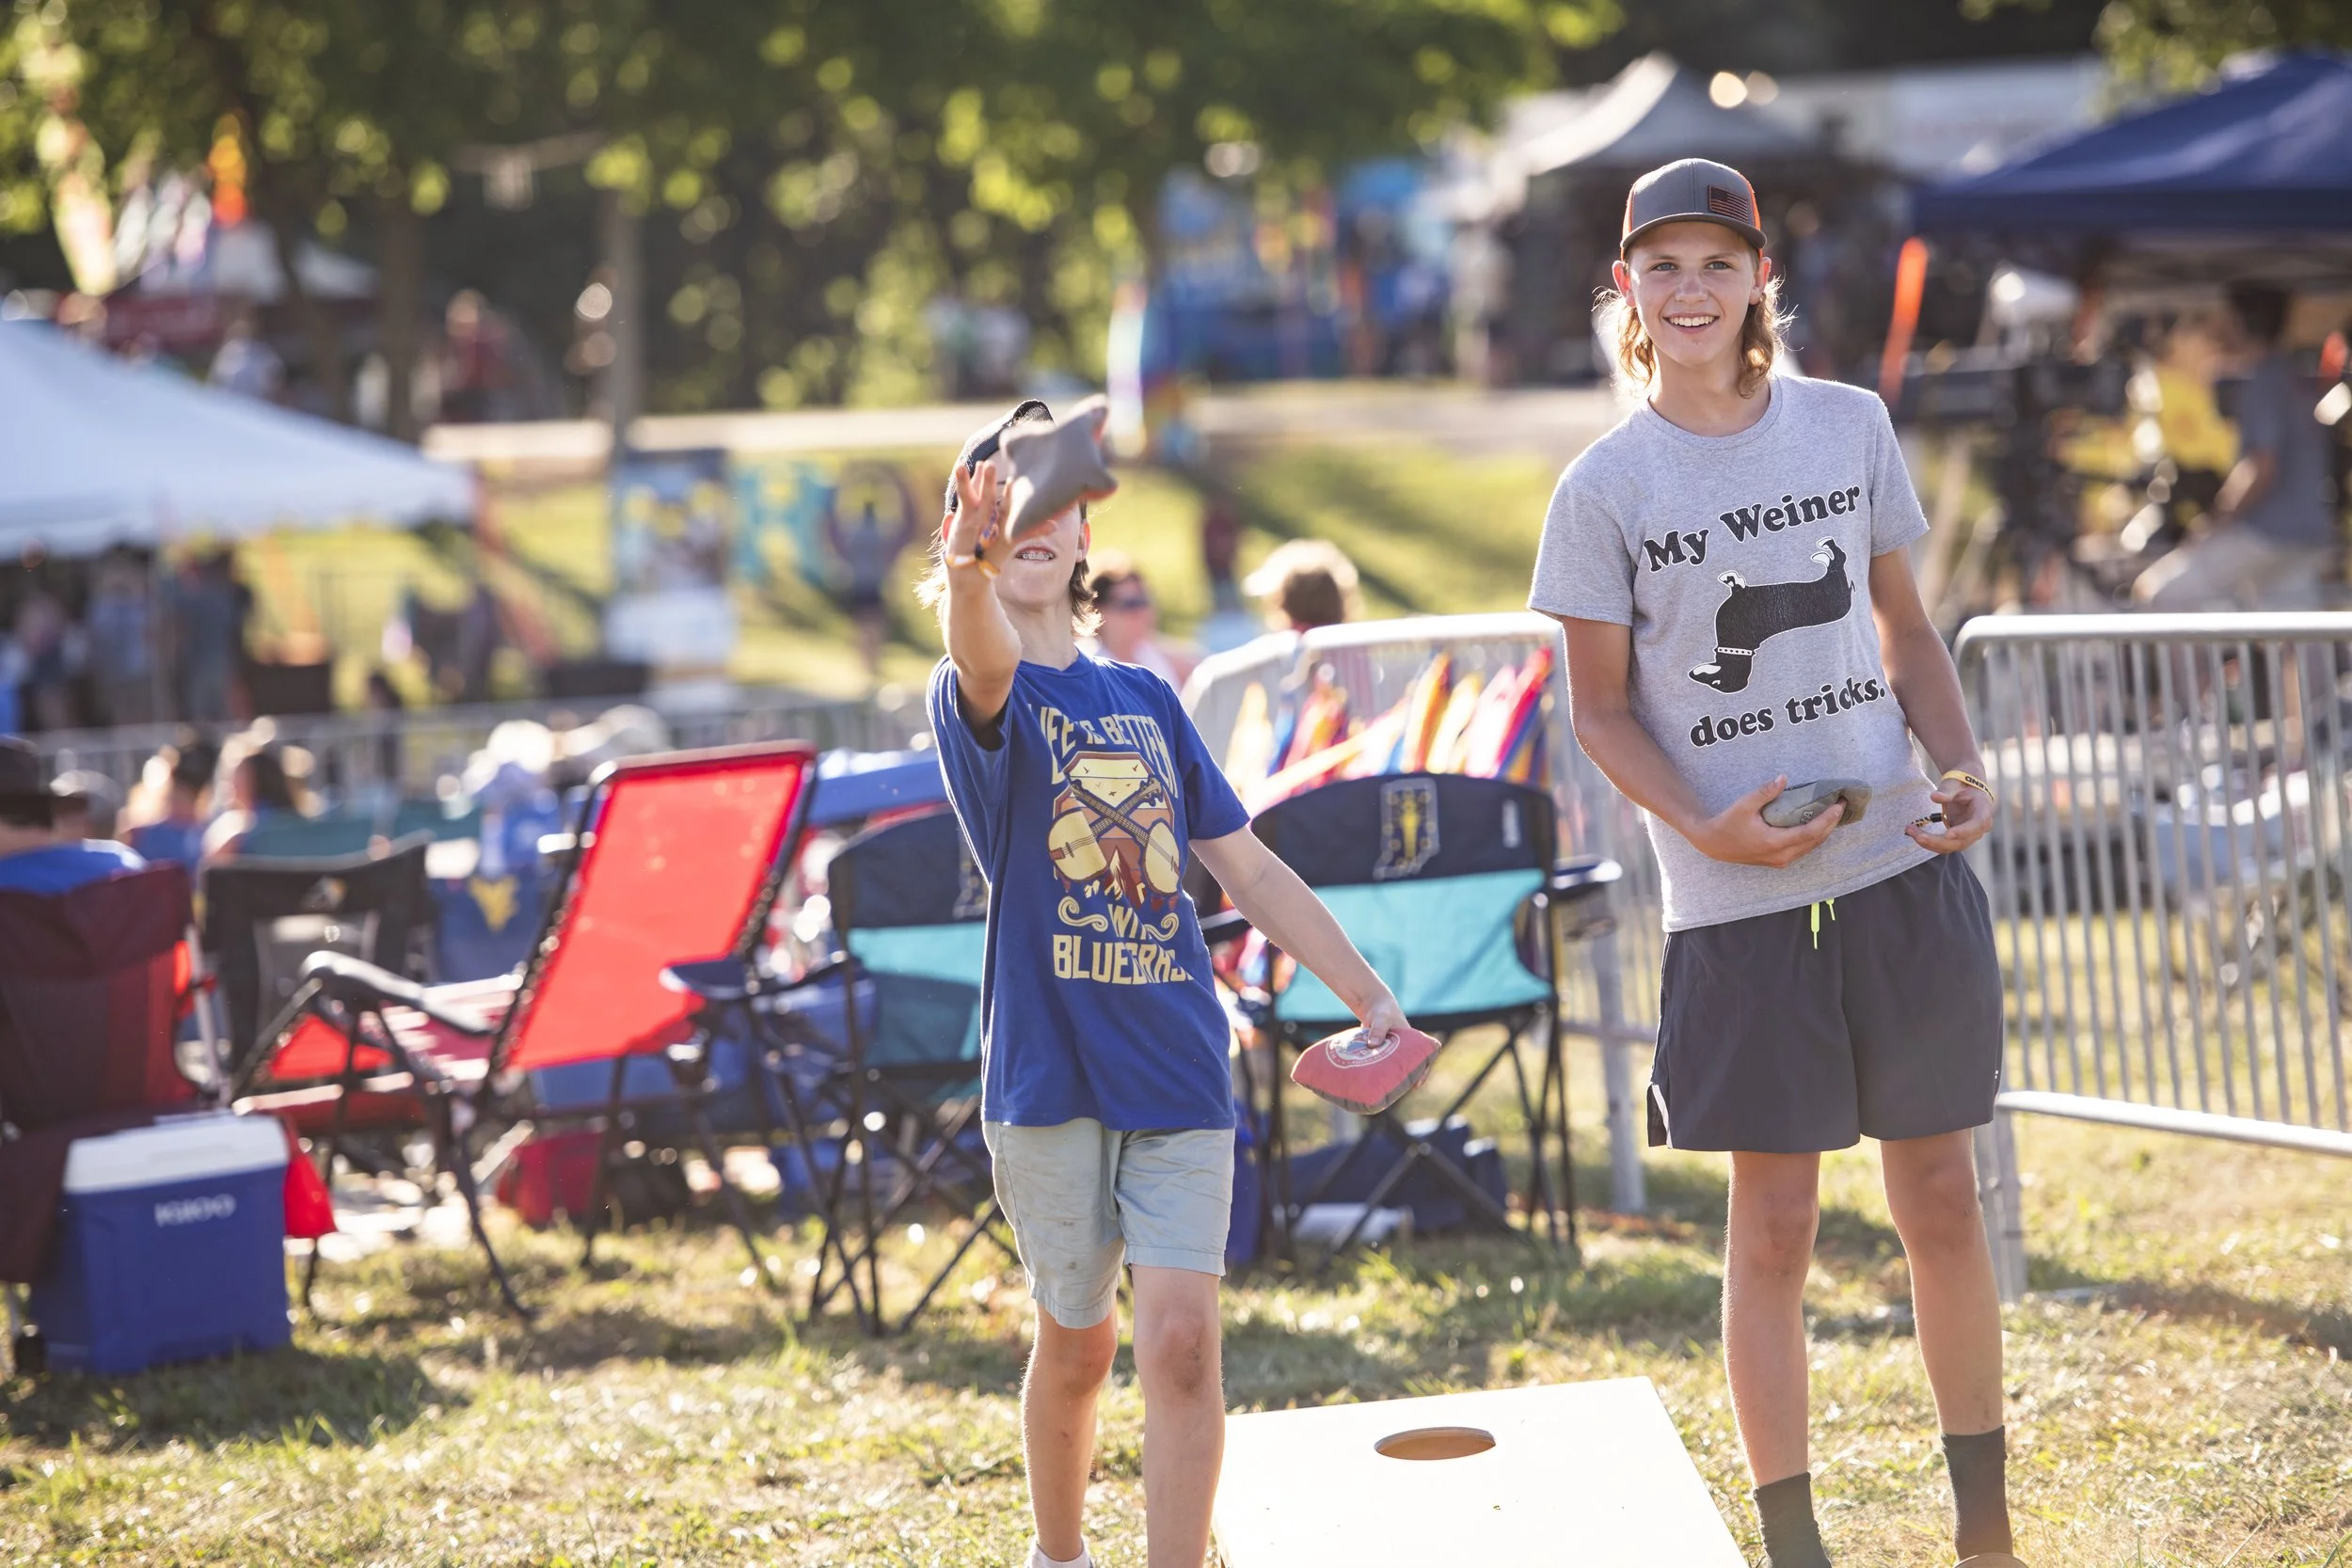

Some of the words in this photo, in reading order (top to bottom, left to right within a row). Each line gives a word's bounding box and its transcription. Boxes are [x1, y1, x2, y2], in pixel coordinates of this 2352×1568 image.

[1644, 530, 1709, 573] My
[1719, 485, 1861, 543] Weiner
[1690, 706, 1774, 748] does
[1785, 676, 1885, 724] tricks.
